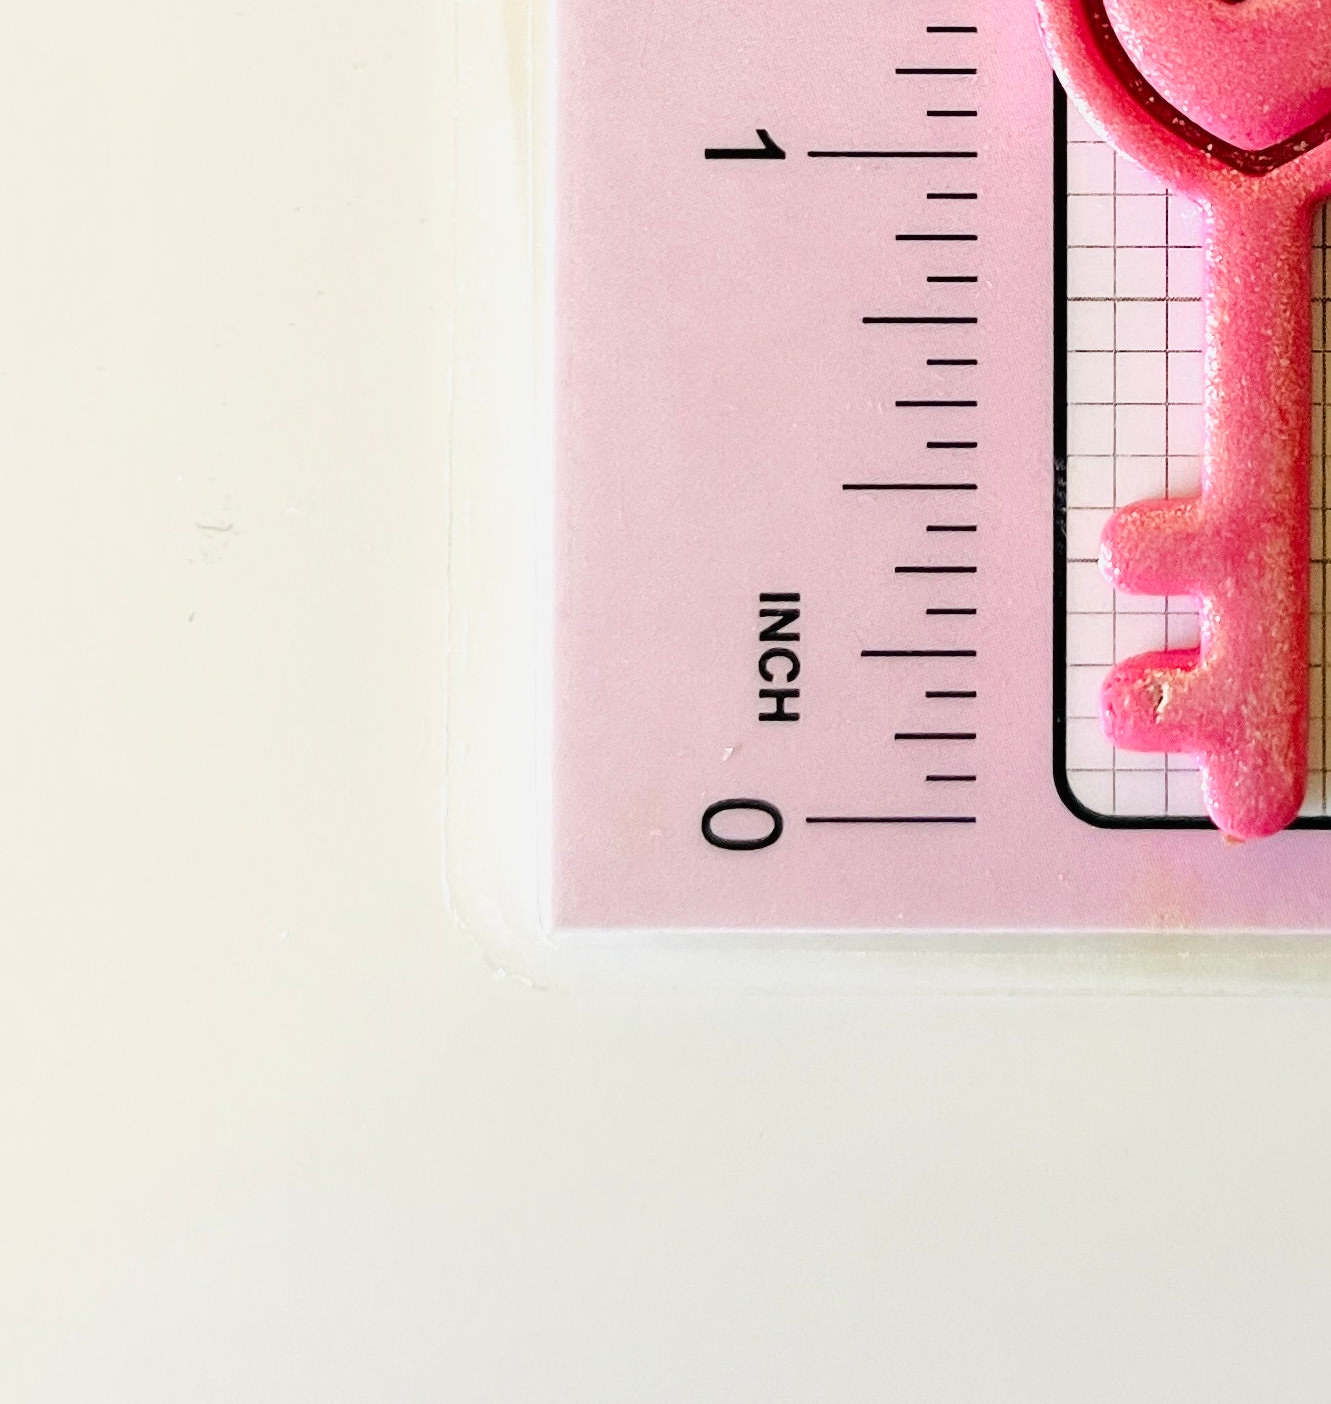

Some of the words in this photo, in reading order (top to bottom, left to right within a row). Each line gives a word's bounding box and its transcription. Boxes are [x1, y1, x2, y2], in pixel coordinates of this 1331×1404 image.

[703, 127, 786, 161] 1
[757, 592, 801, 722] INCH
[700, 797, 784, 852] 0
